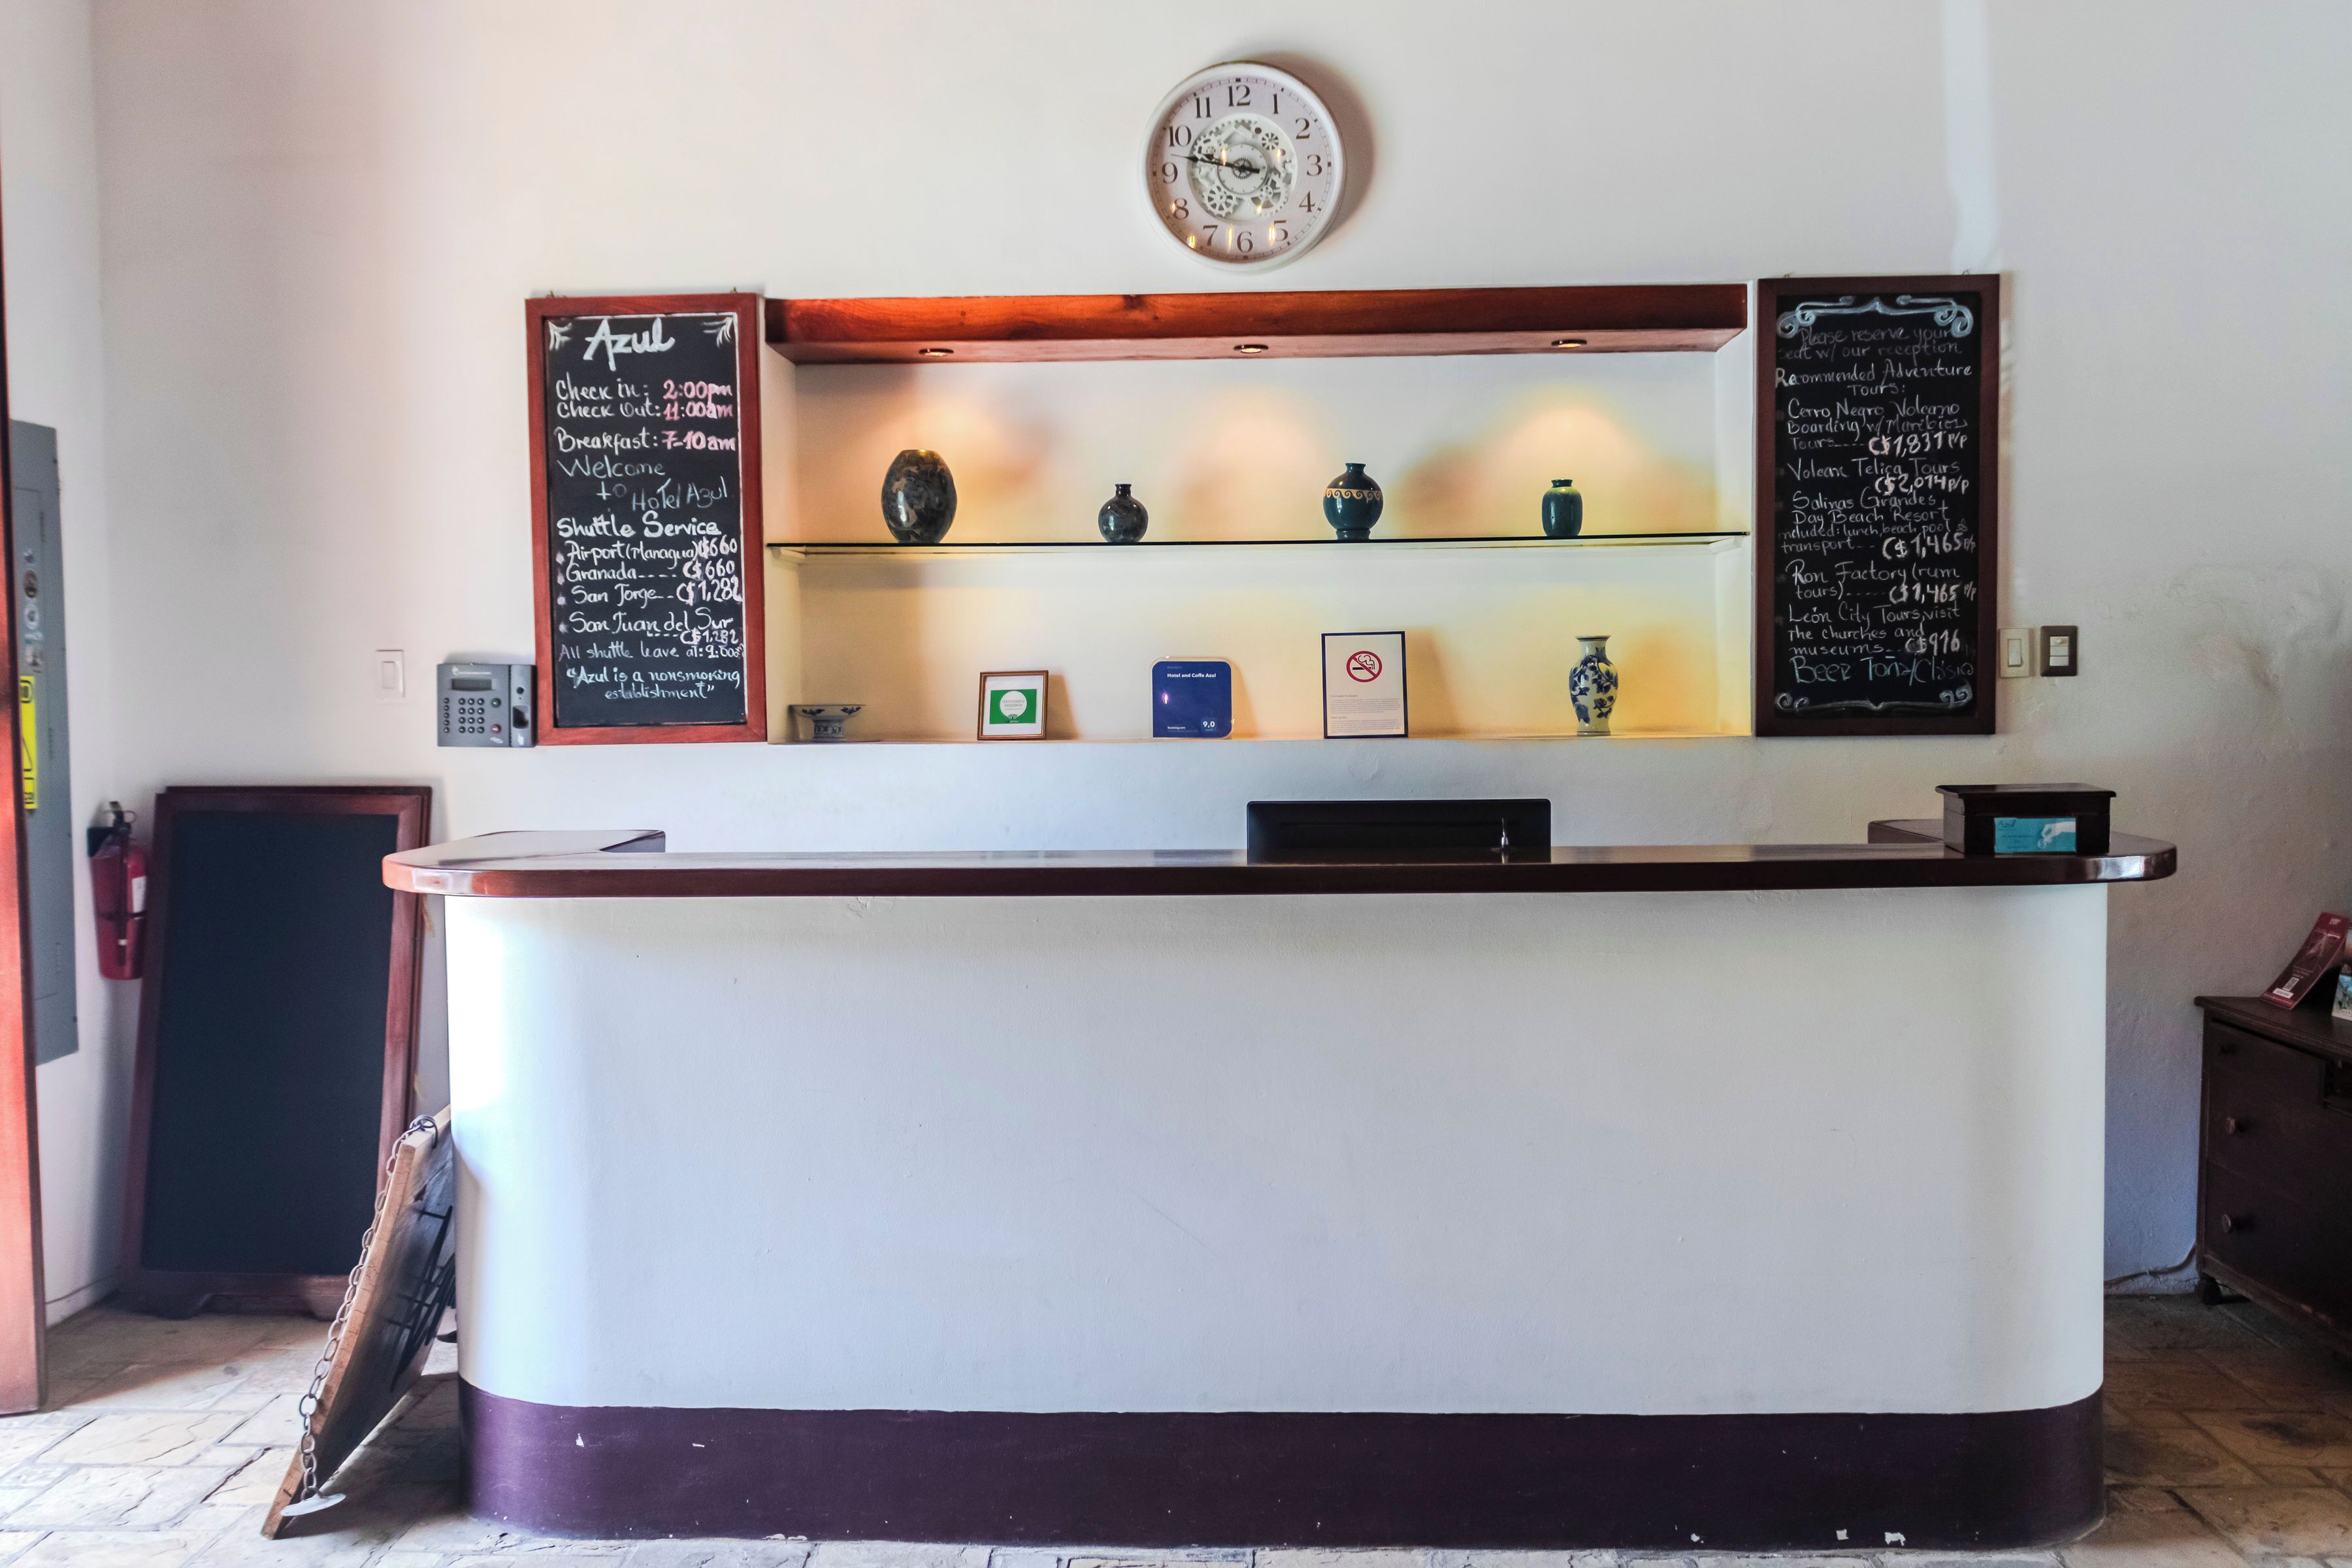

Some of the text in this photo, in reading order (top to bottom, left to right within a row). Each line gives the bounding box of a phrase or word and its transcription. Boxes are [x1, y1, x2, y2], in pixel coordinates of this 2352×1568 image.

[1228, 85, 1250, 106] 12
[1273, 93, 1279, 114] 1
[1196, 97, 1211, 118] 11
[1169, 125, 1192, 146] 10
[1296, 118, 1311, 139] 2
[1162, 162, 1178, 184] 9
[1306, 154, 1322, 176] 3
[1173, 198, 1189, 220] 8
[1299, 191, 1315, 212] 4
[1202, 225, 1218, 246] 7
[1237, 231, 1253, 252] 6
[1273, 220, 1288, 241] 5
[583, 317, 676, 371] Azul
[1842, 346, 1867, 357] our
[1878, 341, 1963, 367] reception
[1882, 359, 1972, 388] Adventure
[556, 372, 613, 401] Check
[557, 400, 615, 418] Check
[1788, 395, 1960, 426] Cerro Negro Volcano
[1788, 417, 1860, 442] Boarding
[557, 455, 666, 478] Welcome
[1851, 457, 1902, 476] Telica
[1908, 457, 1961, 477] Tours
[596, 481, 627, 500] to
[1793, 486, 1936, 510] Salinas Grandes
[557, 510, 721, 538] Shuttle Service
[1791, 499, 1950, 532] Day Beach Resort
[1786, 559, 1829, 585] Ron
[1835, 560, 1906, 586] Factory
[571, 585, 609, 604] San
[569, 607, 734, 634] San Juan del Sur
[1838, 601, 1870, 631] City
[1822, 625, 1887, 640] churches
[1894, 621, 1925, 637] and
[558, 644, 581, 662] All
[587, 641, 634, 659] shuttle
[640, 640, 679, 658] leave
[613, 667, 629, 682] is
[632, 672, 645, 682] a
[648, 670, 740, 689] nonsmoking
